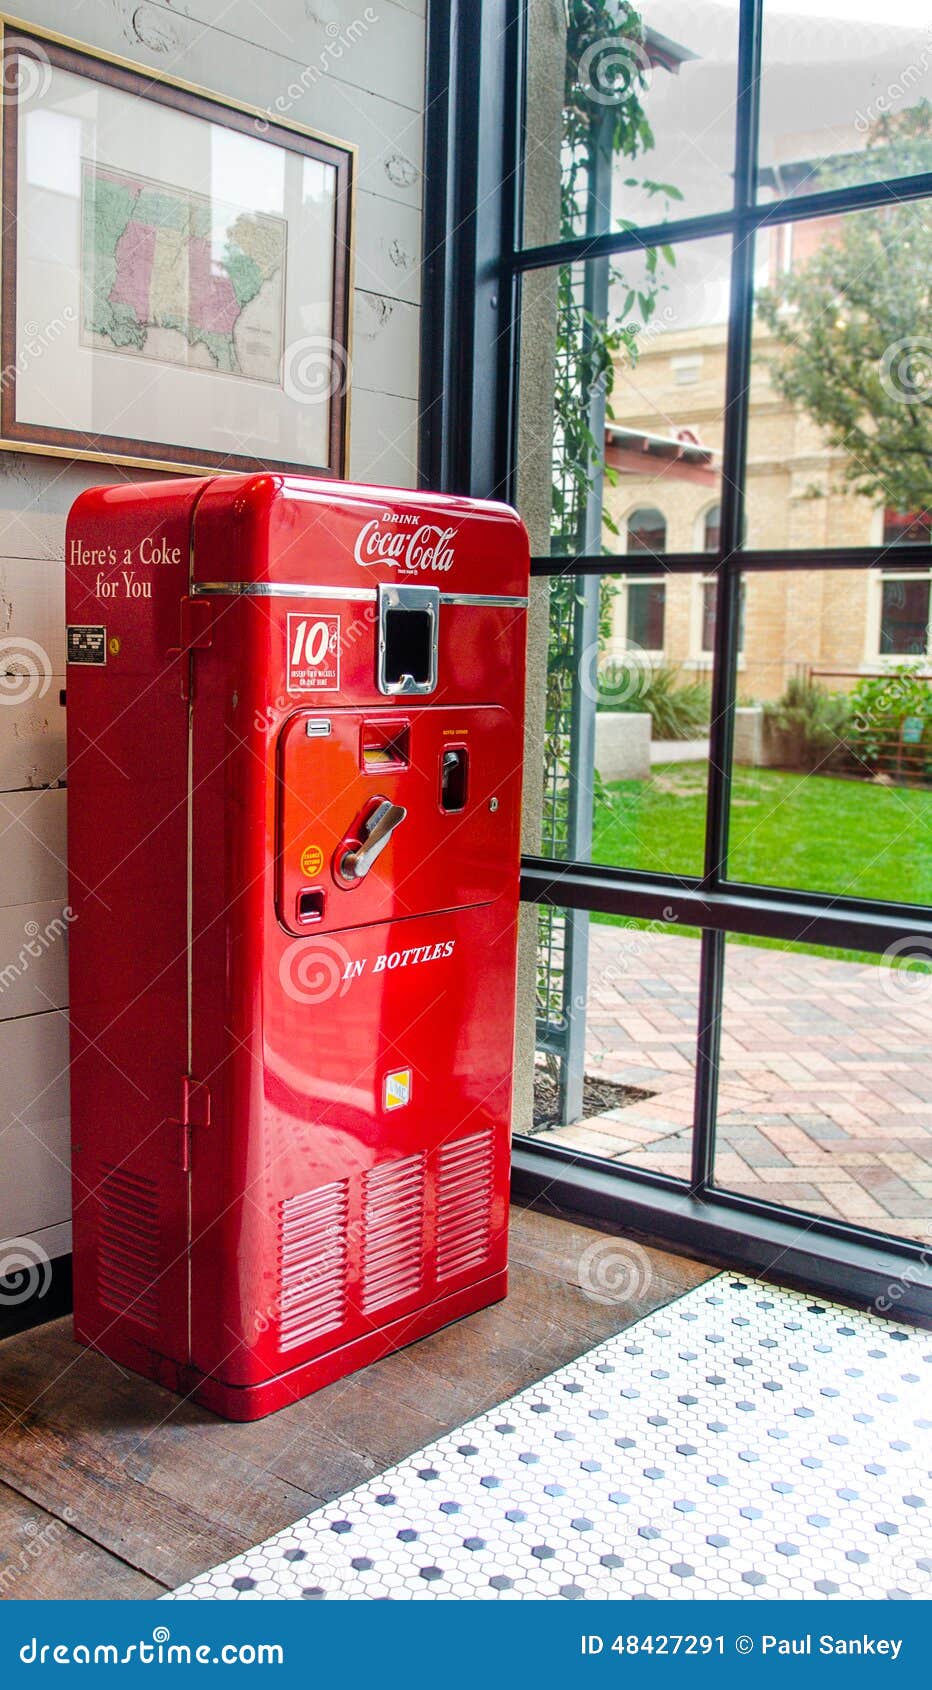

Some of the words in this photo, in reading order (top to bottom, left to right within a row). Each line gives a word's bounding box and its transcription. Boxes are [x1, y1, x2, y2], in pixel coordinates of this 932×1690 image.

[382, 512, 420, 525] DRINK
[70, 540, 117, 566] Here's
[123, 549, 132, 565] a
[140, 537, 181, 565] Coke
[354, 519, 458, 572] Coca-Cola
[96, 572, 119, 598] for
[122, 571, 152, 598] You
[342, 959, 367, 980] IN
[372, 940, 456, 973] BOTTLES
